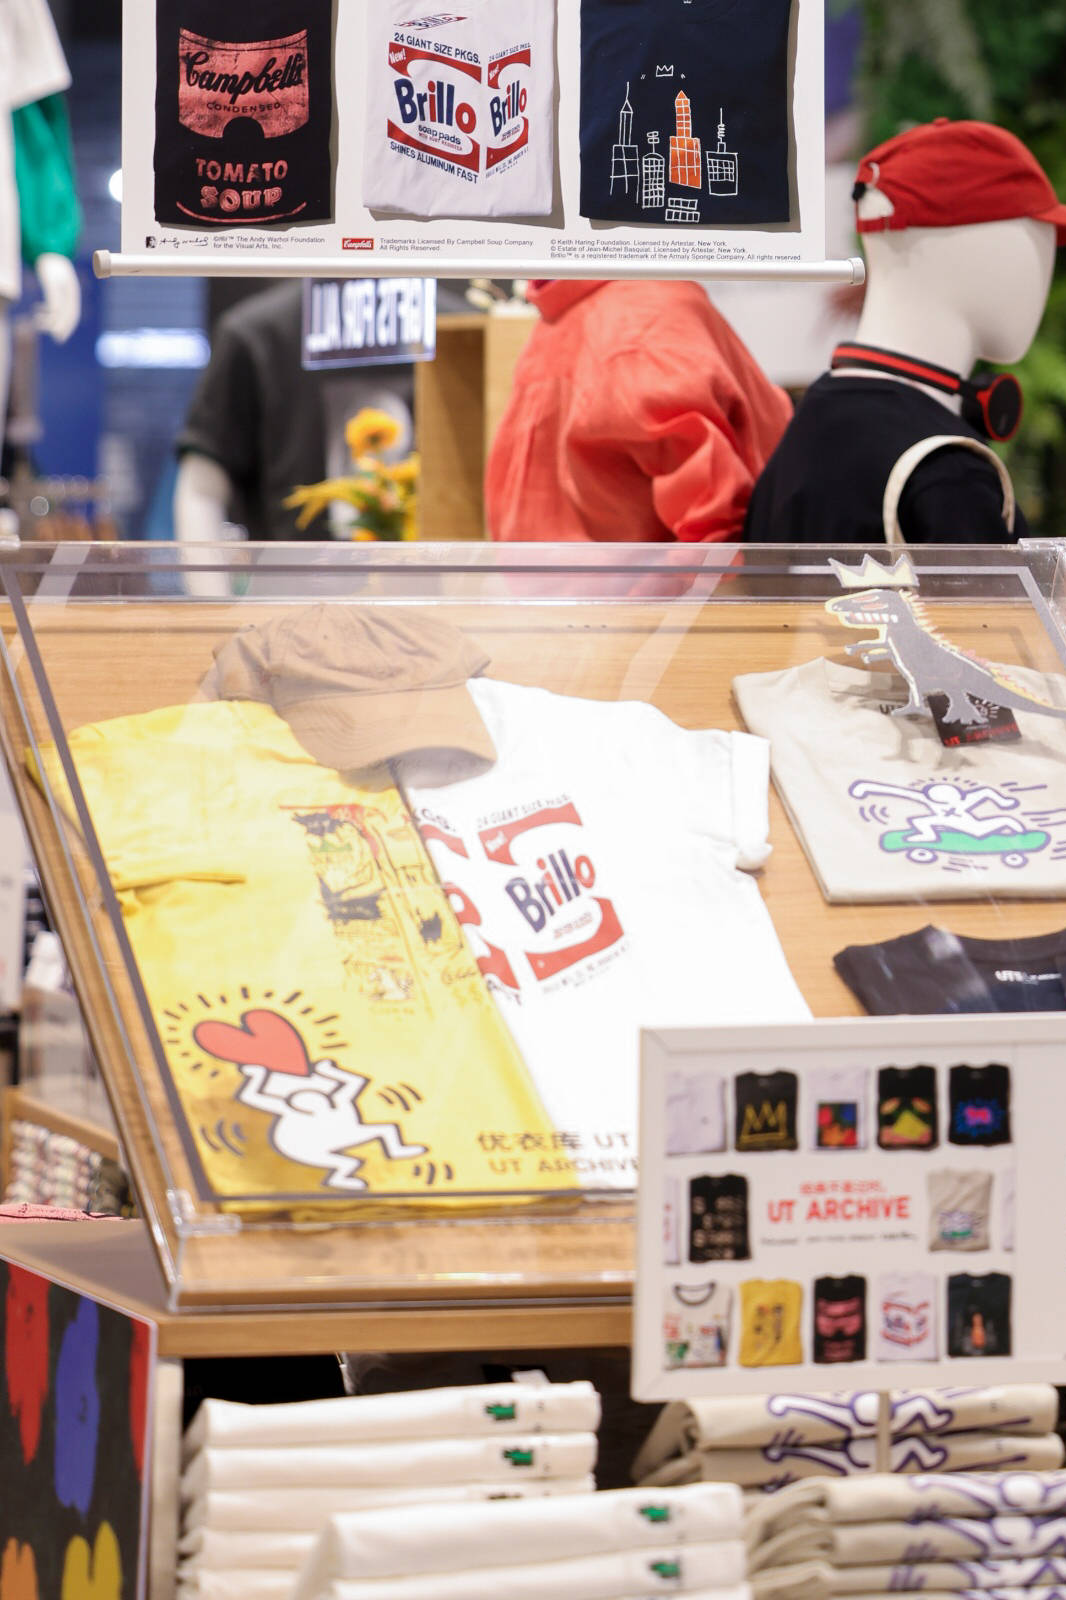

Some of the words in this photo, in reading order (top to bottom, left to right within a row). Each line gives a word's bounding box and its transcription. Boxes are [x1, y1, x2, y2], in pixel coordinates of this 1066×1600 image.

[389, 48, 407, 64] New!
[394, 32, 404, 43] 24
[406, 35, 433, 51] GIANT
[434, 42, 453, 56] SIZE
[454, 48, 481, 65] PKGS.
[206, 101, 282, 114] CONDENSED
[394, 78, 477, 134] Brillo
[490, 79, 527, 137] Brillo
[418, 124, 438, 140] soap
[438, 131, 461, 145] pads
[195, 158, 288, 184] TOMATO
[390, 141, 420, 160] SHINES
[416, 153, 455, 175] ALUMINUM
[456, 169, 478, 184] FAST
[200, 185, 283, 212] SOUP
[250, 236, 265, 244] Andy
[456, 238, 485, 246] Campbell
[487, 239, 501, 247] Soup
[505, 848, 595, 934] Brillo
[594, 1133, 630, 1148] UT
[488, 1158, 522, 1174] UT
[805, 1195, 911, 1223] ARCHIVE
